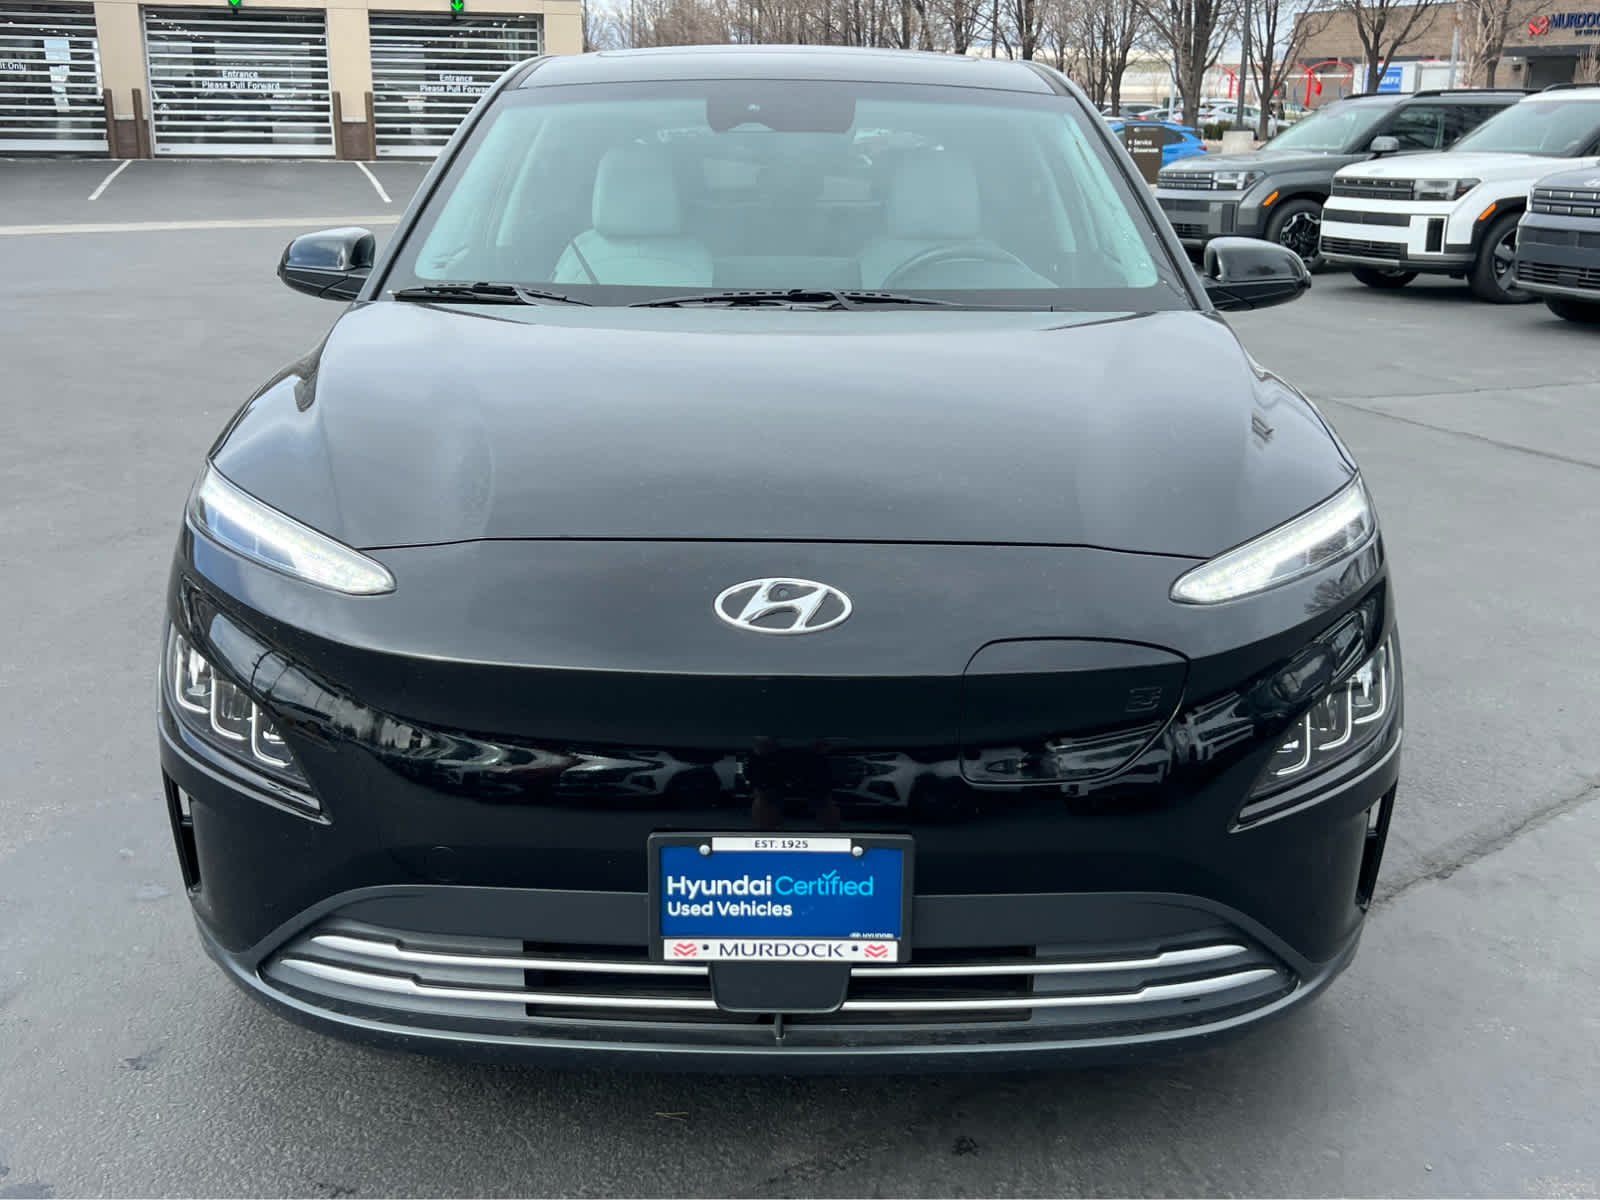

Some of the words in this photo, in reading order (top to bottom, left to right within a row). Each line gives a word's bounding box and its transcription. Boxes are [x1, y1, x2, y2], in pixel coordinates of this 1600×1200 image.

[222, 70, 259, 79] Entrance
[440, 74, 473, 83] Entrance
[201, 80, 228, 90] Please
[230, 81, 246, 90] Pull
[247, 81, 281, 91] Forward
[420, 84, 445, 93] Please
[754, 839, 778, 849] EST.
[781, 839, 809, 849] 1925
[667, 874, 772, 900] Hyundai
[774, 869, 875, 896] Certified
[667, 901, 714, 917] Used
[716, 901, 793, 917] Vehicles
[719, 942, 845, 958] MURDOCK
